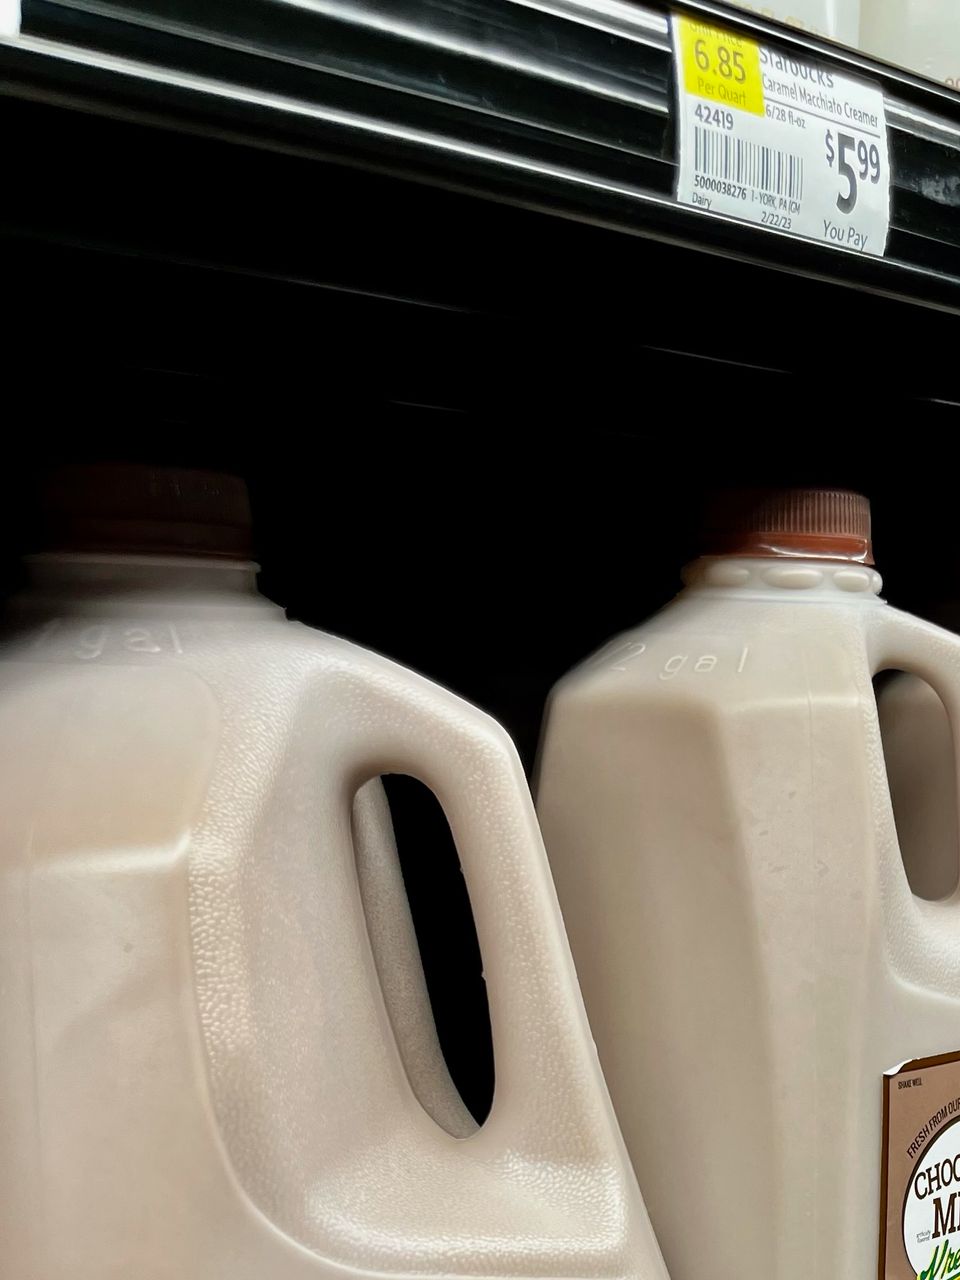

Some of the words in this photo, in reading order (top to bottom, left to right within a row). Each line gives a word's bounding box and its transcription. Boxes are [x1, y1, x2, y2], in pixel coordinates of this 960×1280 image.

[695, 39, 746, 84] 6.85
[697, 77, 716, 95] Per
[718, 84, 747, 106] Quart
[762, 75, 798, 101] Caramel
[799, 87, 842, 117] Macchiato
[844, 102, 878, 128] Creamer
[695, 103, 734, 131] 42419
[692, 192, 712, 210] Dairy
[761, 211, 792, 230] 2/22/23
[823, 219, 845, 241] You
[847, 227, 868, 251] Pay
